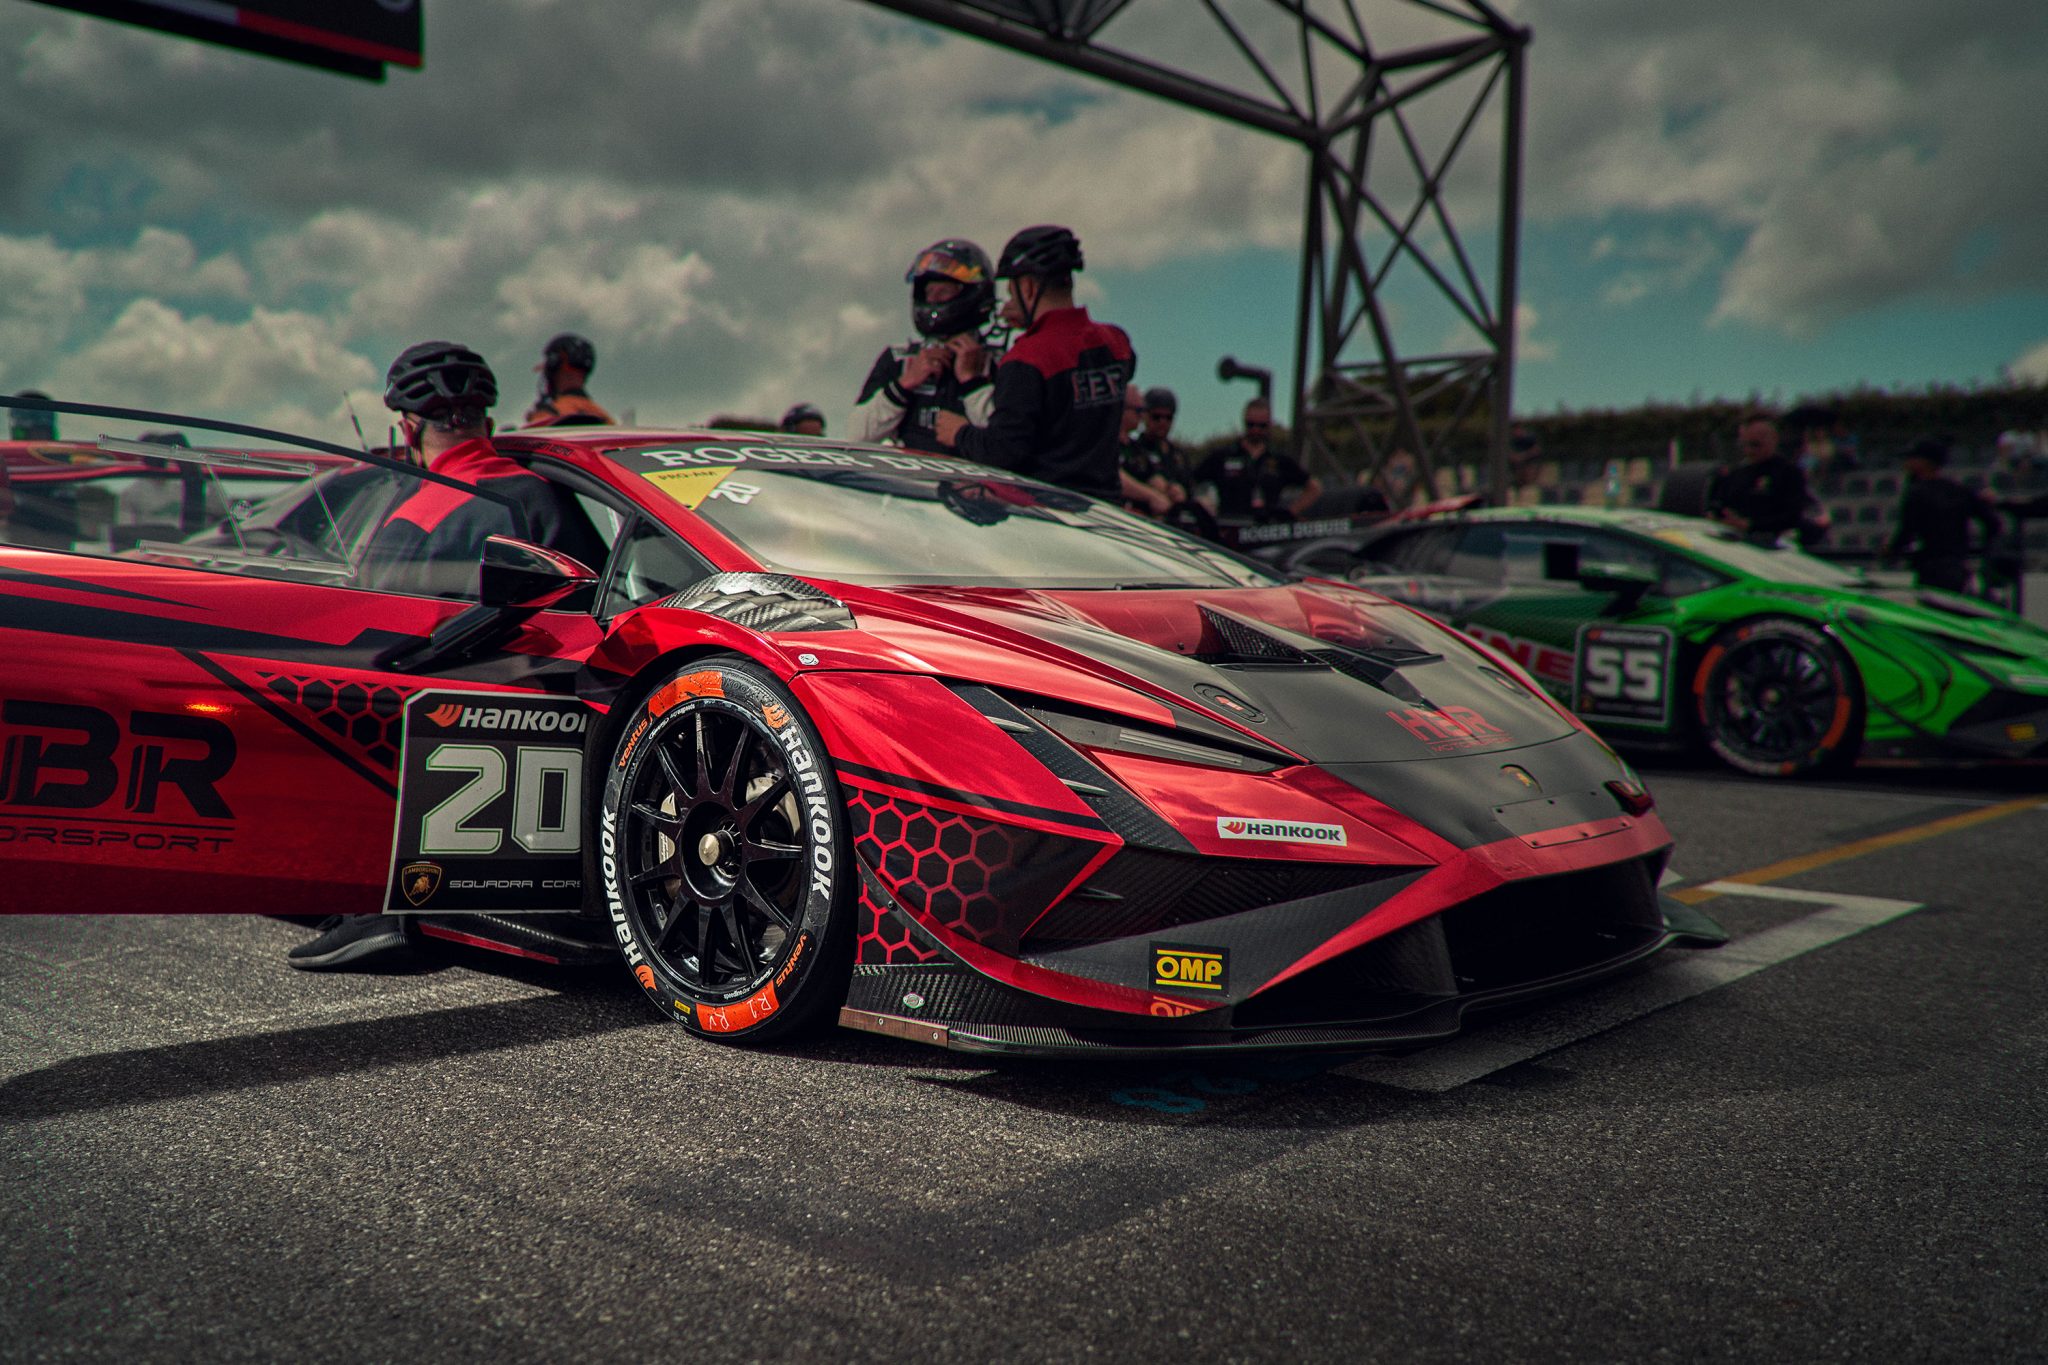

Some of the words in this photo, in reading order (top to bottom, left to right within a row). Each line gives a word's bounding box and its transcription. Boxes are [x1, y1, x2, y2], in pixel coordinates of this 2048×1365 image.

[641, 447, 873, 467] ROGER
[1585, 647, 1661, 701] 55
[420, 744, 584, 854] 20
[449, 879, 534, 889] SQUADRA
[1156, 956, 1223, 982] OMP
